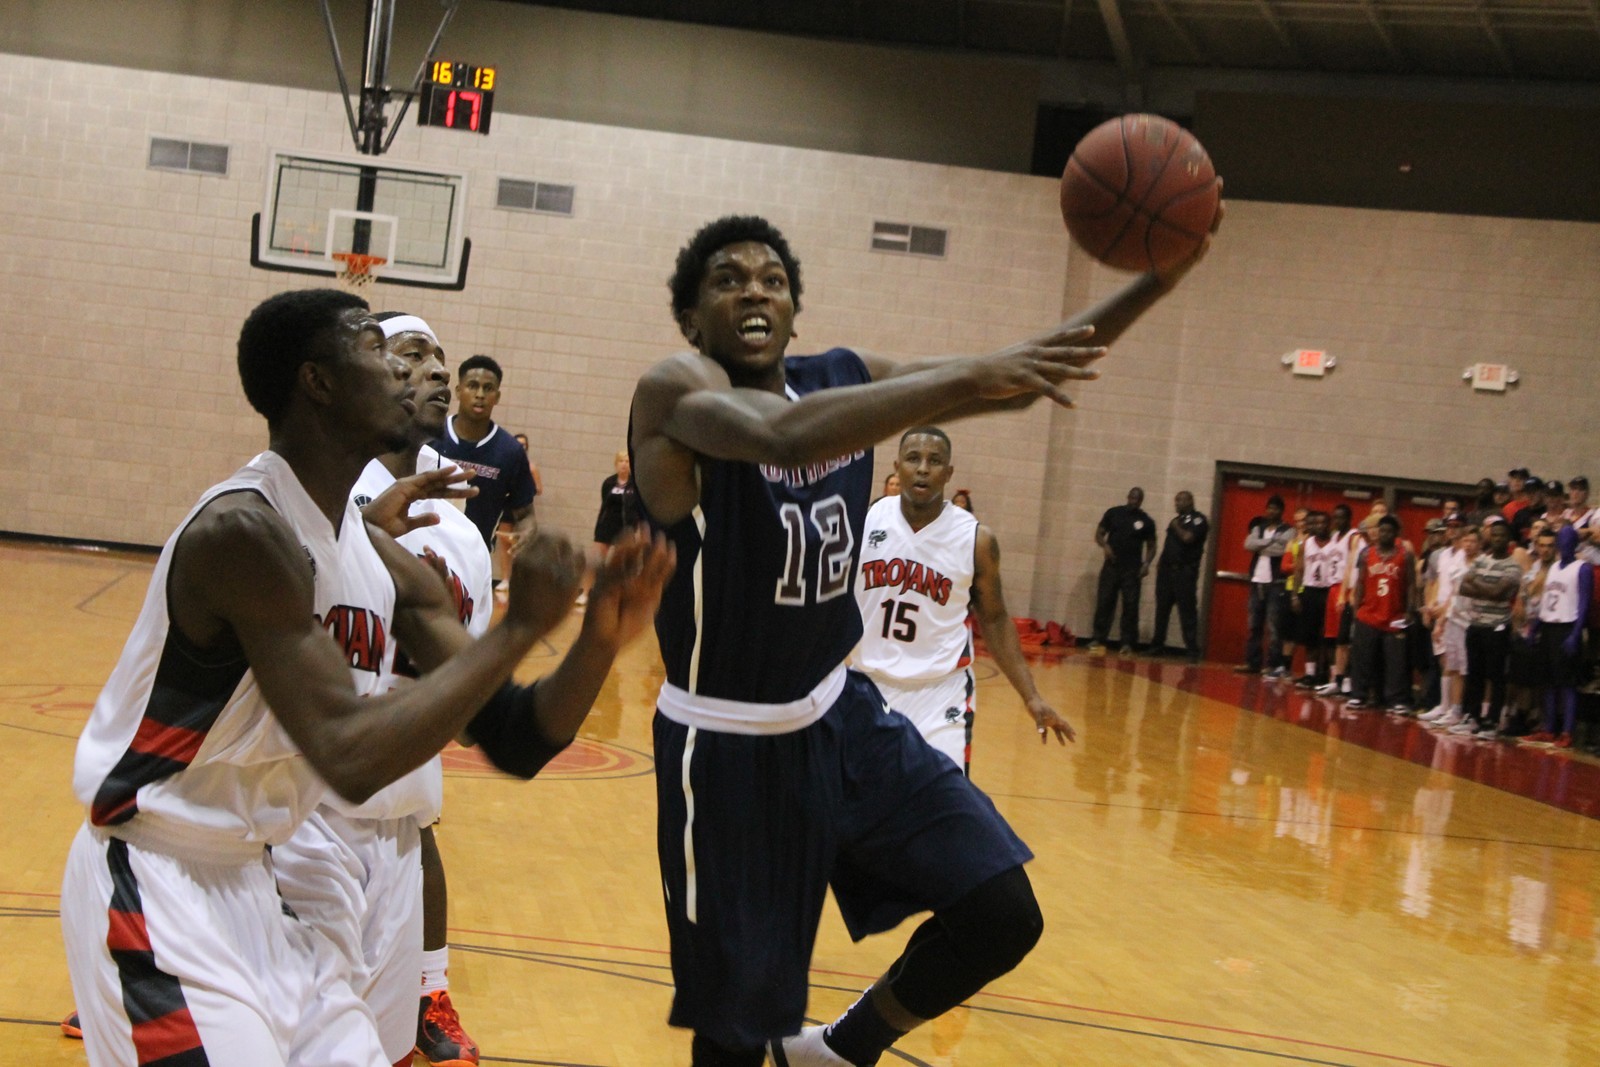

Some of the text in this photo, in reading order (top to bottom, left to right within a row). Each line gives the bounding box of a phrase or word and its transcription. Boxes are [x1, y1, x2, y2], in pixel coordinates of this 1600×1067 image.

[445, 90, 481, 131] 17
[774, 493, 855, 607] 12
[861, 557, 953, 607] TROJANS
[1376, 577, 1390, 597] 5
[880, 598, 919, 643] 15
